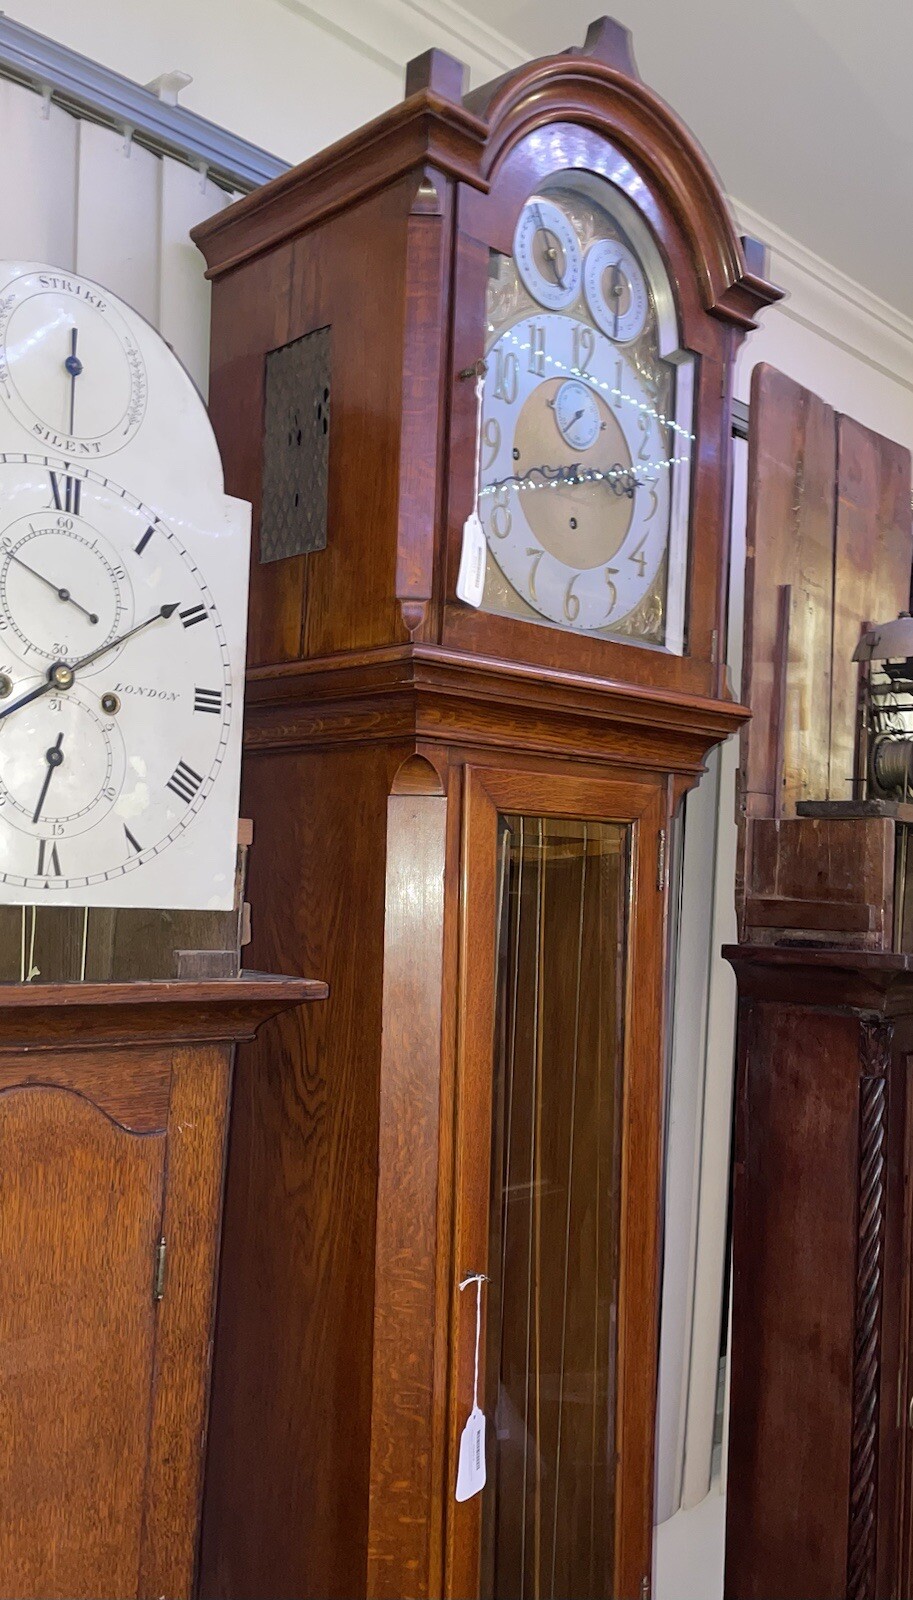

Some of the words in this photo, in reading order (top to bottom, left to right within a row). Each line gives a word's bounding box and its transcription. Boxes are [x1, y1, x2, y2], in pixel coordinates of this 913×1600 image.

[38, 275, 107, 312] STRIKE
[528, 324, 546, 377] 11
[571, 323, 595, 373] 12
[493, 346, 519, 404] 10
[613, 359, 623, 408] 1
[33, 423, 101, 453] SILENT
[482, 418, 500, 470] 9
[637, 411, 651, 461] 2
[42, 470, 84, 517] XII
[643, 474, 659, 522] 3
[56, 517, 74, 531] 60
[113, 565, 125, 581] 10
[526, 547, 545, 601] 7
[628, 530, 647, 577] 4
[179, 603, 209, 629] II
[564, 573, 581, 621] 6
[605, 567, 619, 618] 5
[52, 643, 69, 655] 30
[48, 699, 62, 712] 31
[113, 683, 180, 701] LONDON
[193, 684, 222, 716] III
[104, 787, 117, 802] 10
[52, 824, 65, 836] 15
